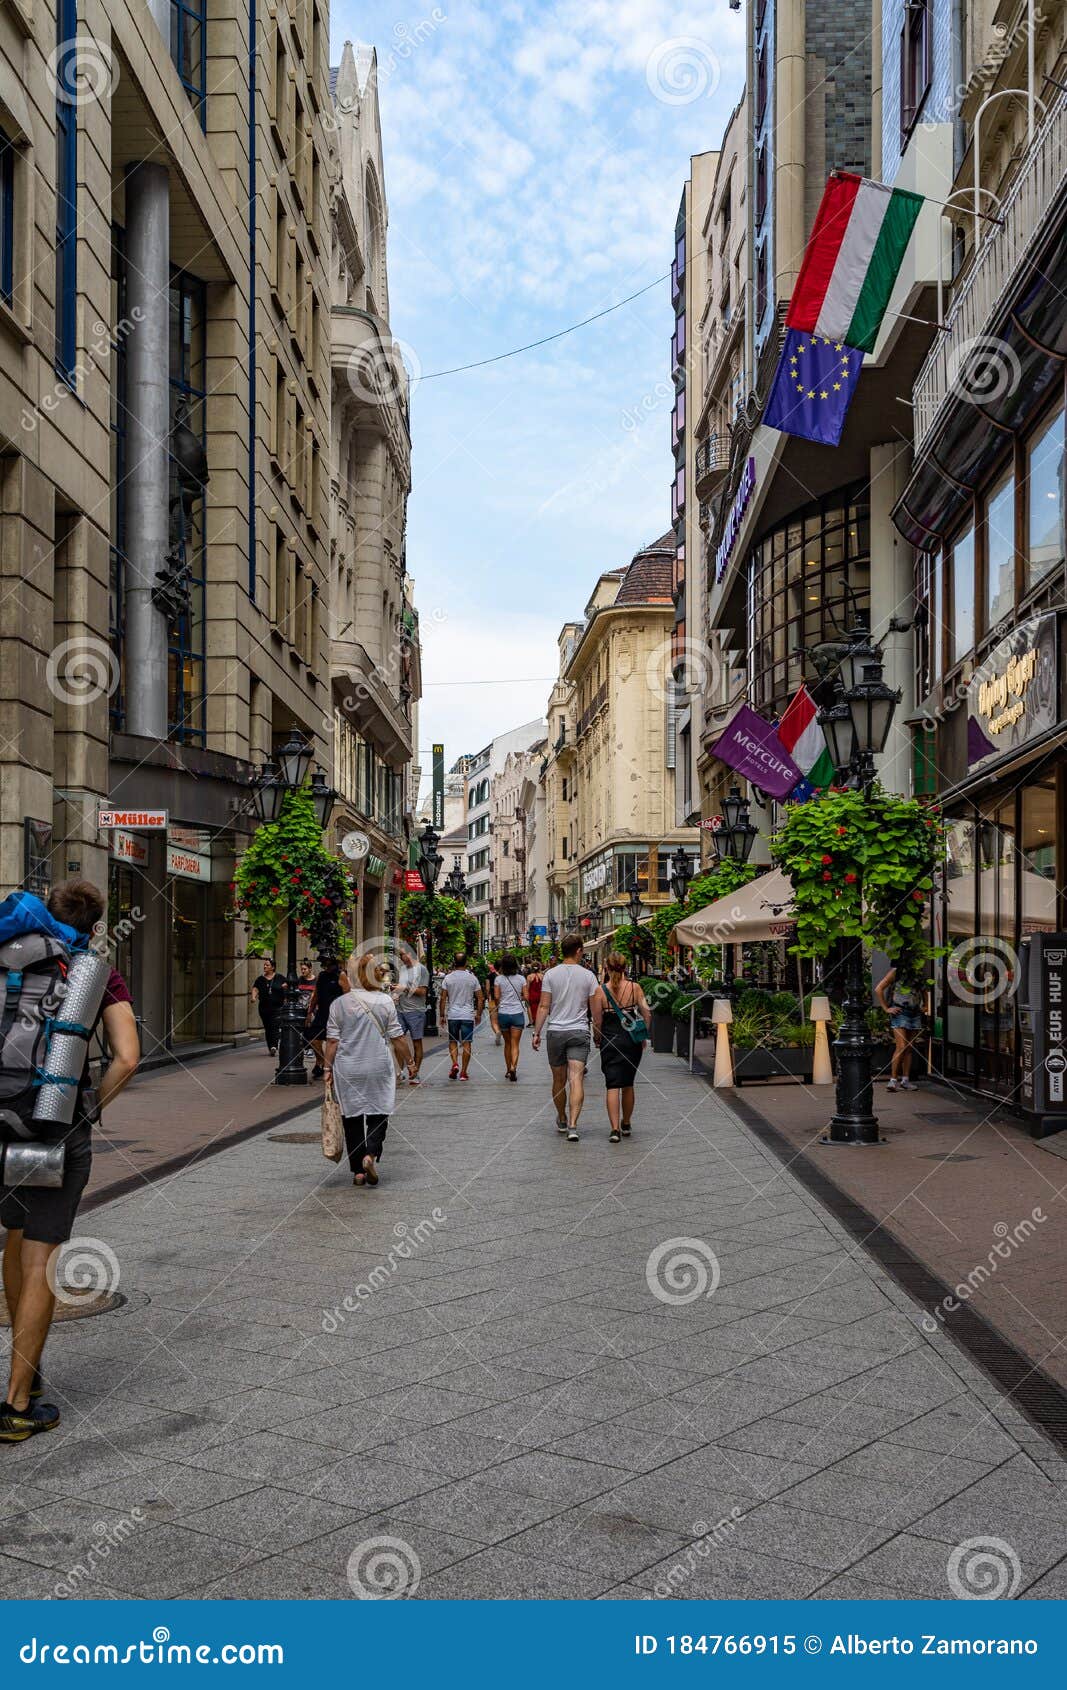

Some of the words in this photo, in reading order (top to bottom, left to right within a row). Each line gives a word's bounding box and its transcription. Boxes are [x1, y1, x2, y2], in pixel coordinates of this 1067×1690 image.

[733, 730, 793, 780] Mercure
[114, 813, 164, 825] Müller
[1050, 972, 1062, 1003] HUF
[1050, 1010, 1062, 1041] EUR
[1053, 1075, 1061, 1093] ATM
